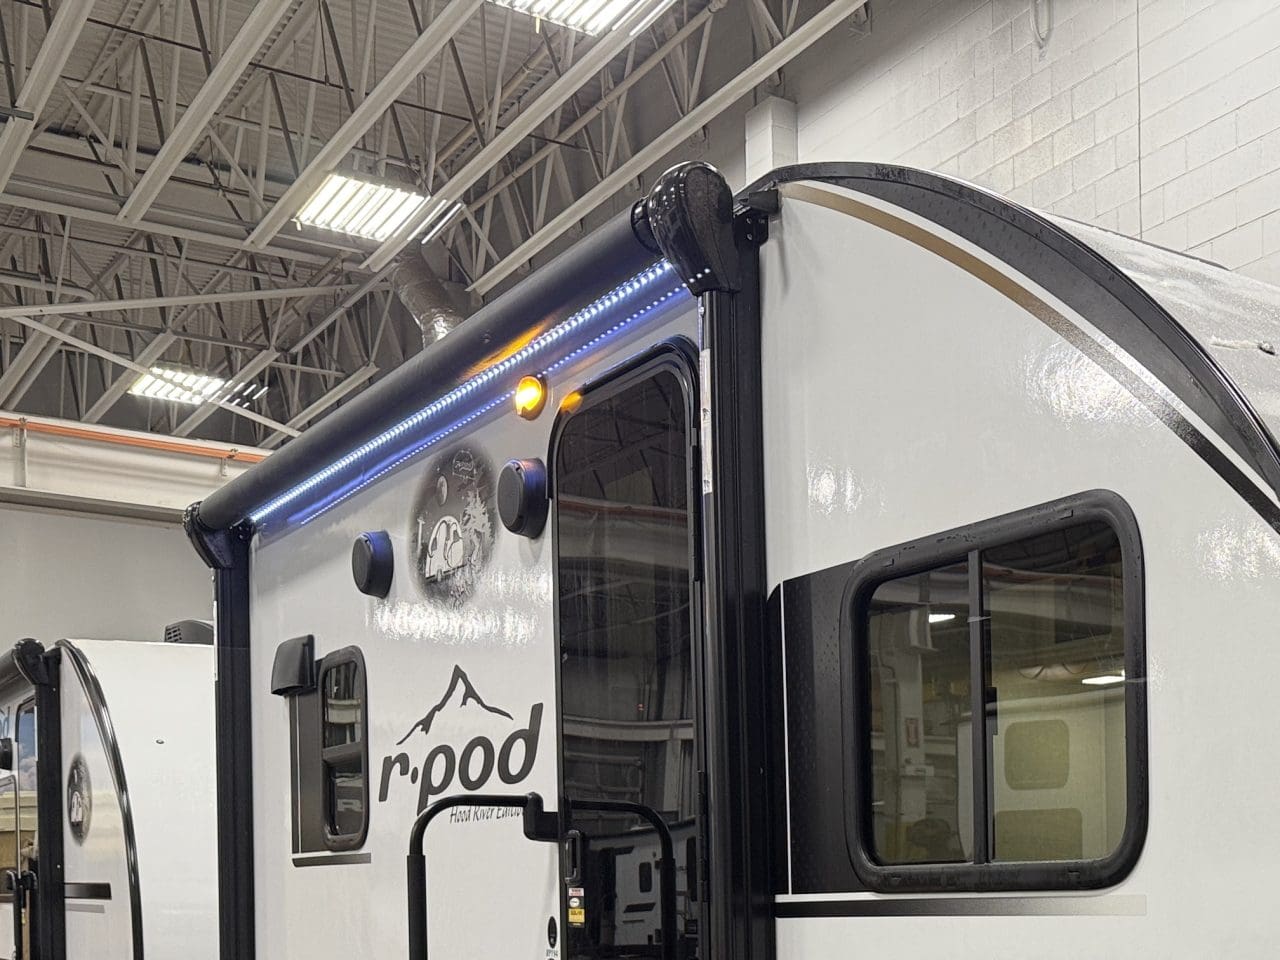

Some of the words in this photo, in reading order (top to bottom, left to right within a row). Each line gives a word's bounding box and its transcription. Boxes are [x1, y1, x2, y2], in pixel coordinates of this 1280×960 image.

[450, 806, 471, 824] Hood
[473, 806, 494, 822] River
[496, 807, 524, 819] Editio
